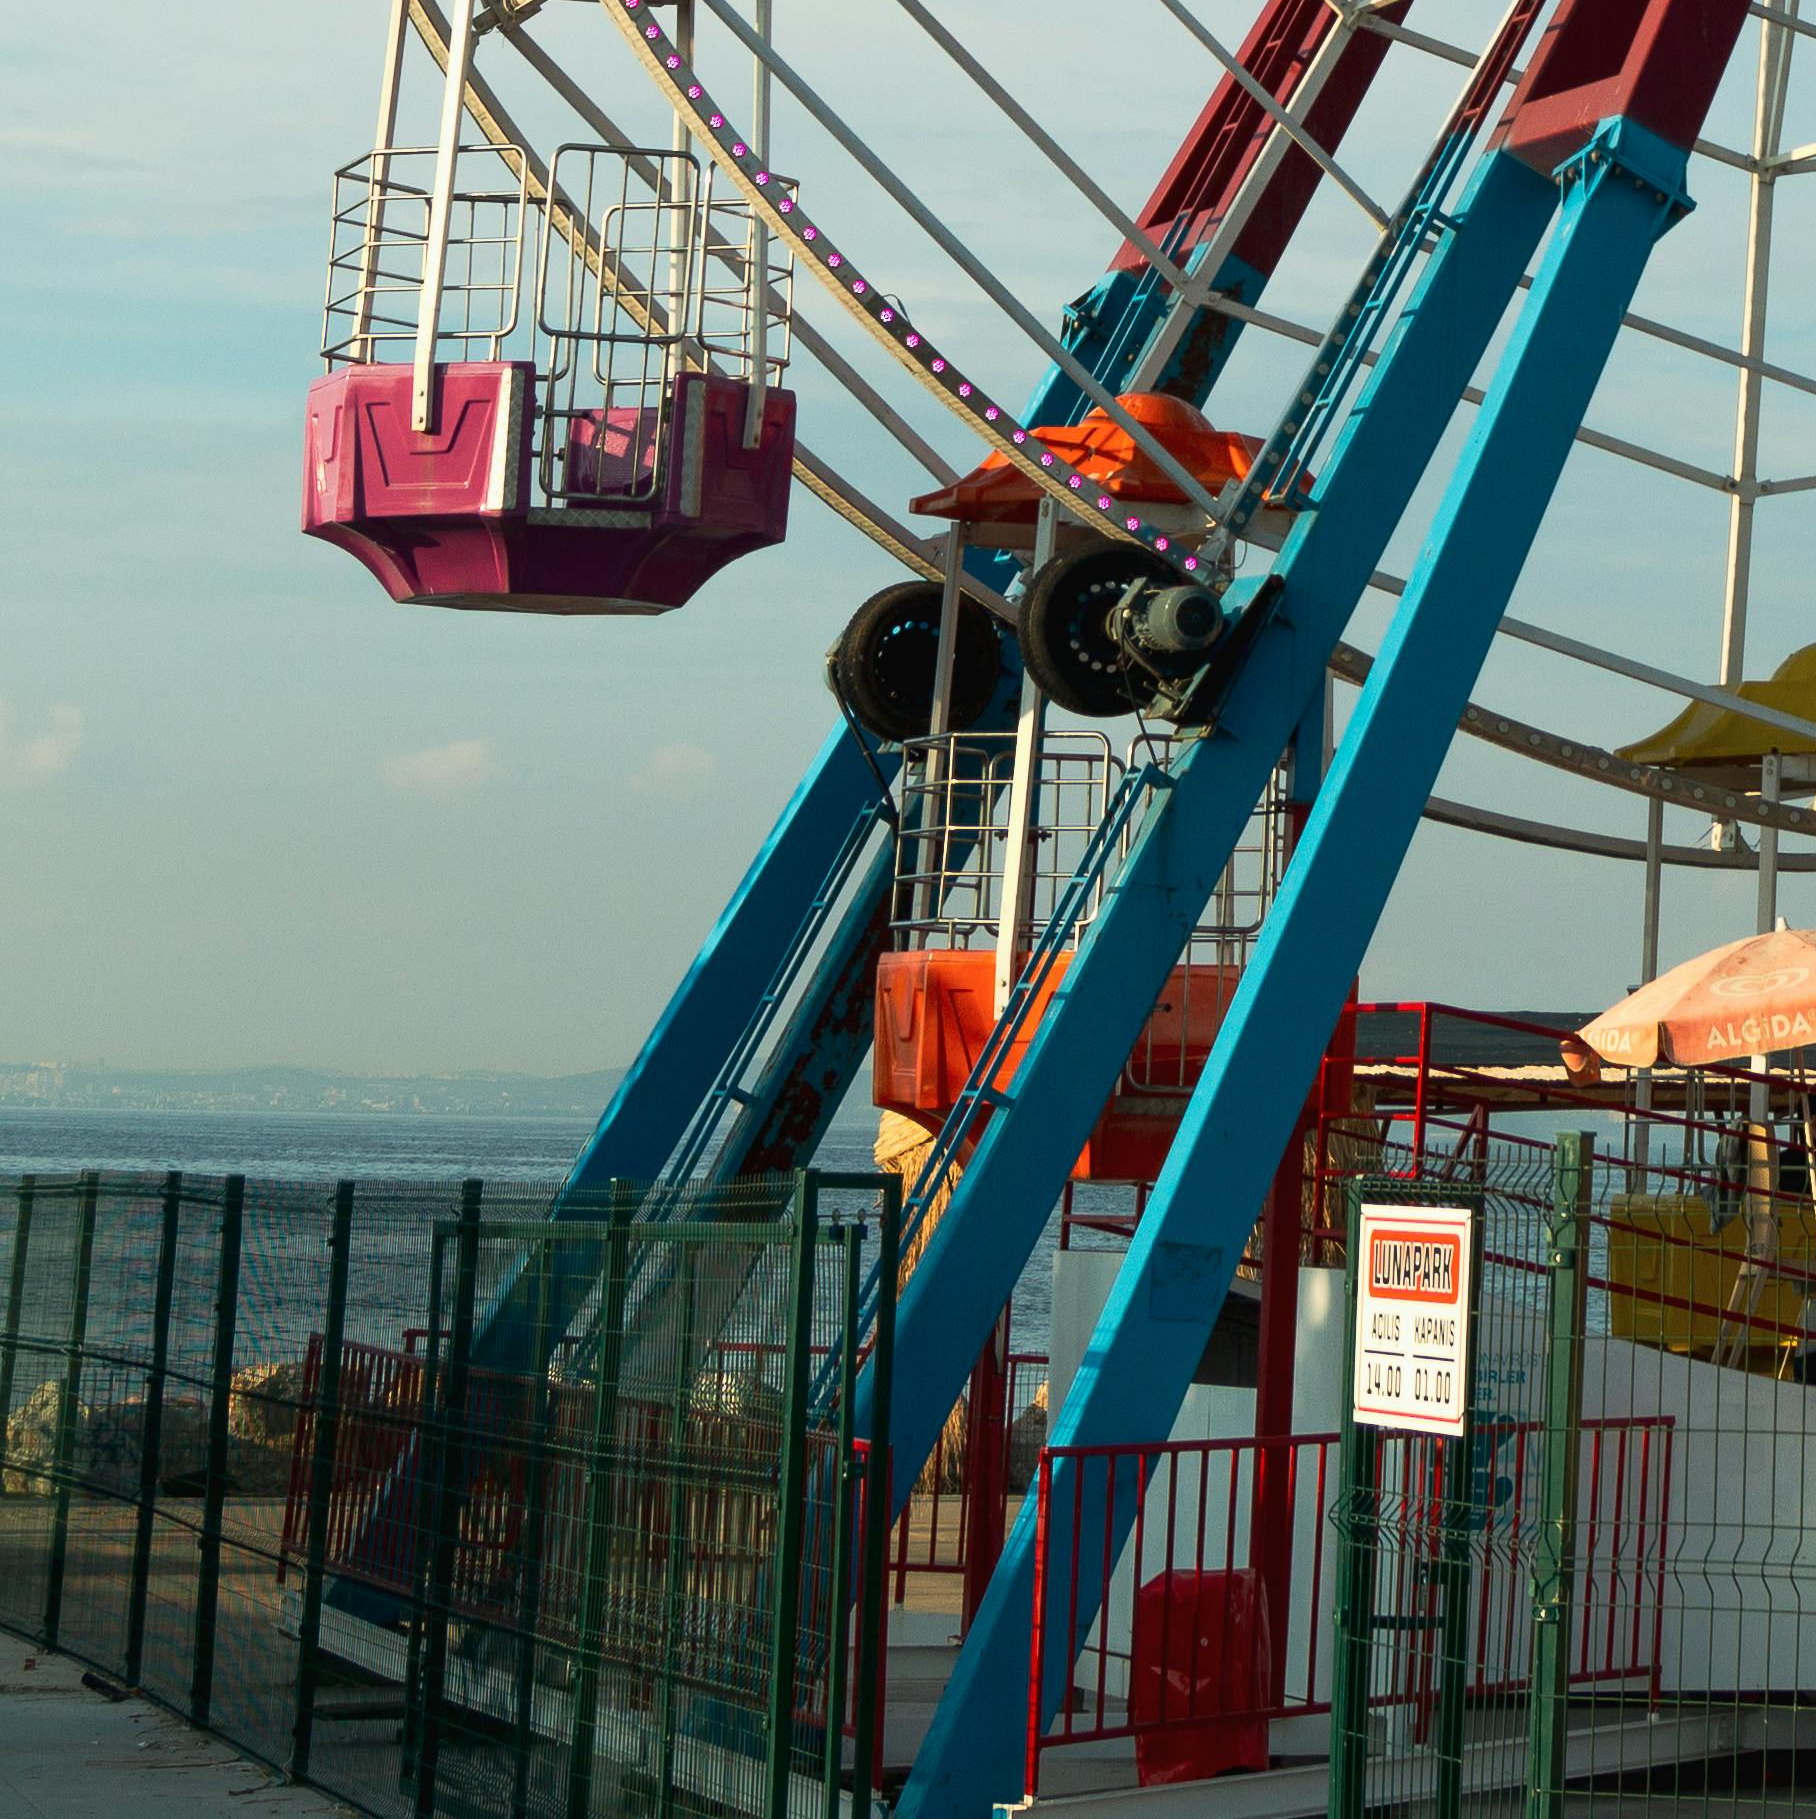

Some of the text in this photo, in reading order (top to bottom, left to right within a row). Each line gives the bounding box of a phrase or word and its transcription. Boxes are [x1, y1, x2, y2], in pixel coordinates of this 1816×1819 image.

[1373, 1241, 1454, 1292] LUNAPARK
[1367, 1362, 1451, 1404] 14.00 01.00
